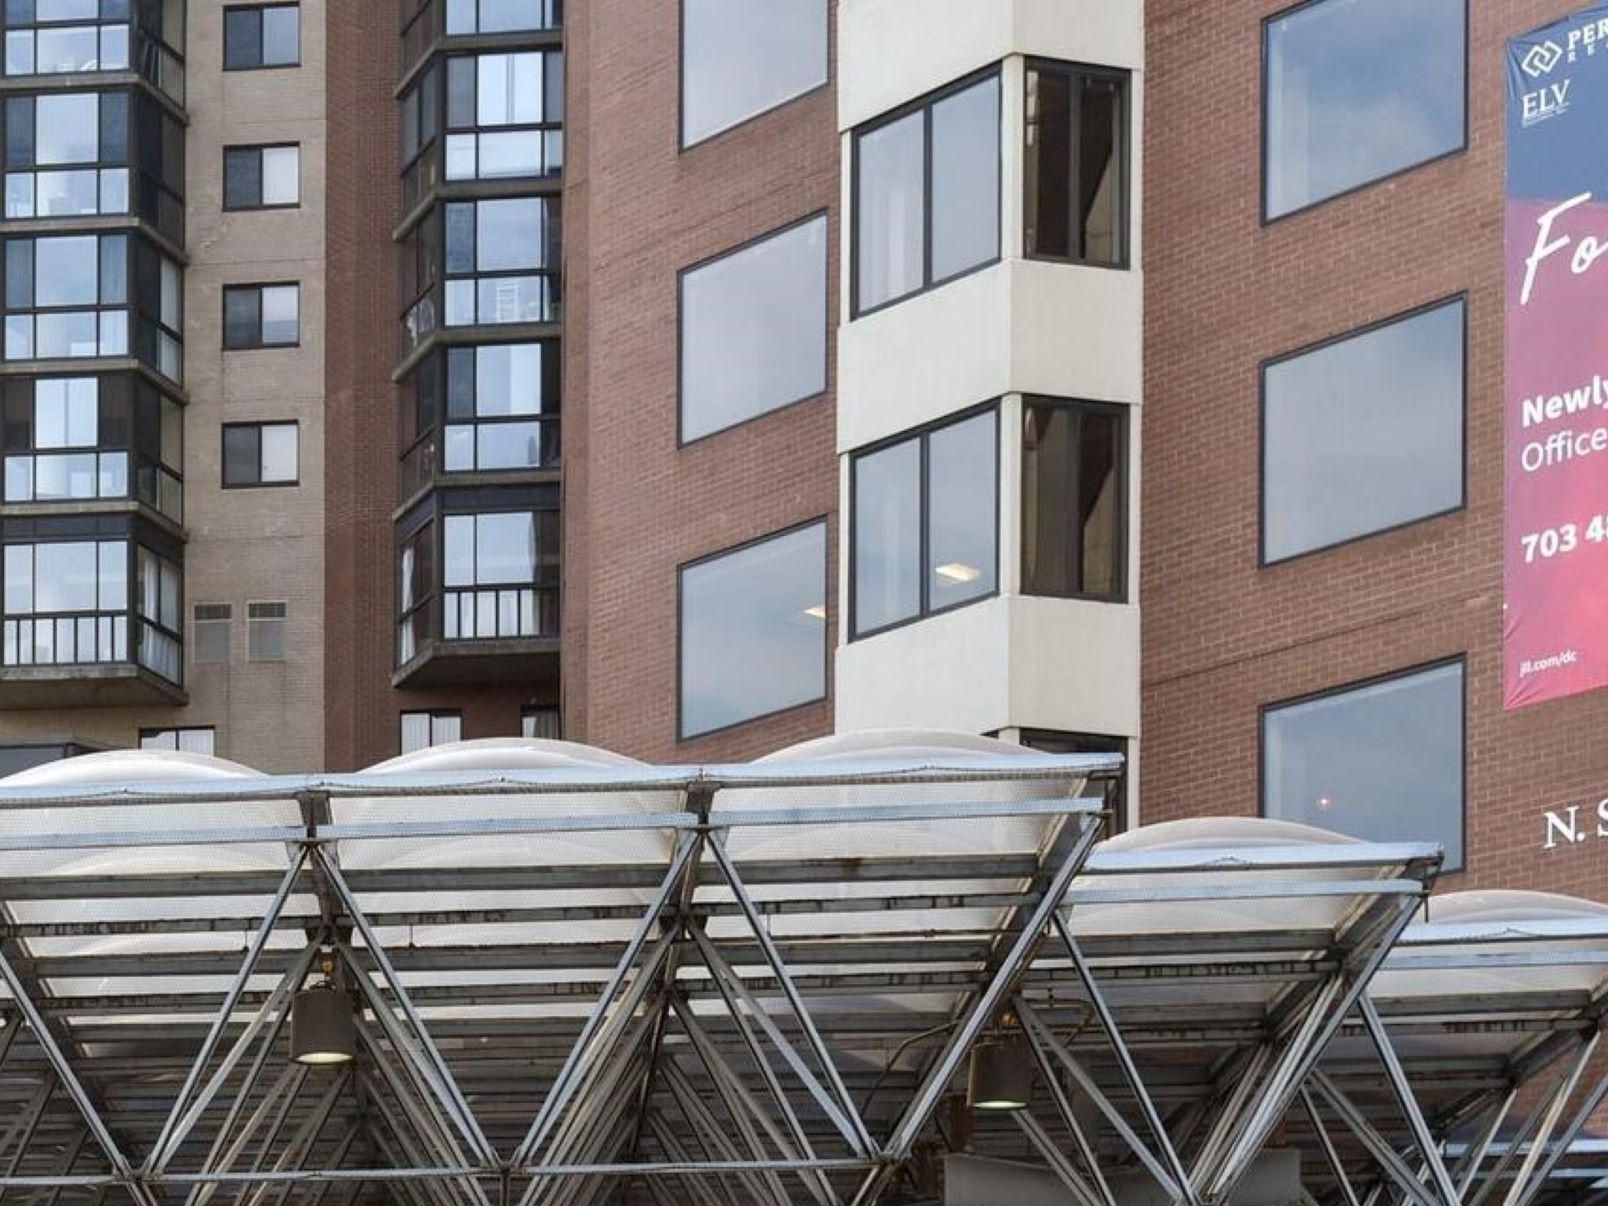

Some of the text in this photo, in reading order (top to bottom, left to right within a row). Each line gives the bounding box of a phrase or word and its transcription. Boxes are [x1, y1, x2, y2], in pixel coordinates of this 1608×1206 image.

[1522, 79, 1570, 119] ELV
[1522, 428, 1608, 472] Office
[1521, 523, 1578, 563] 703
[1544, 805, 1585, 849] N.
